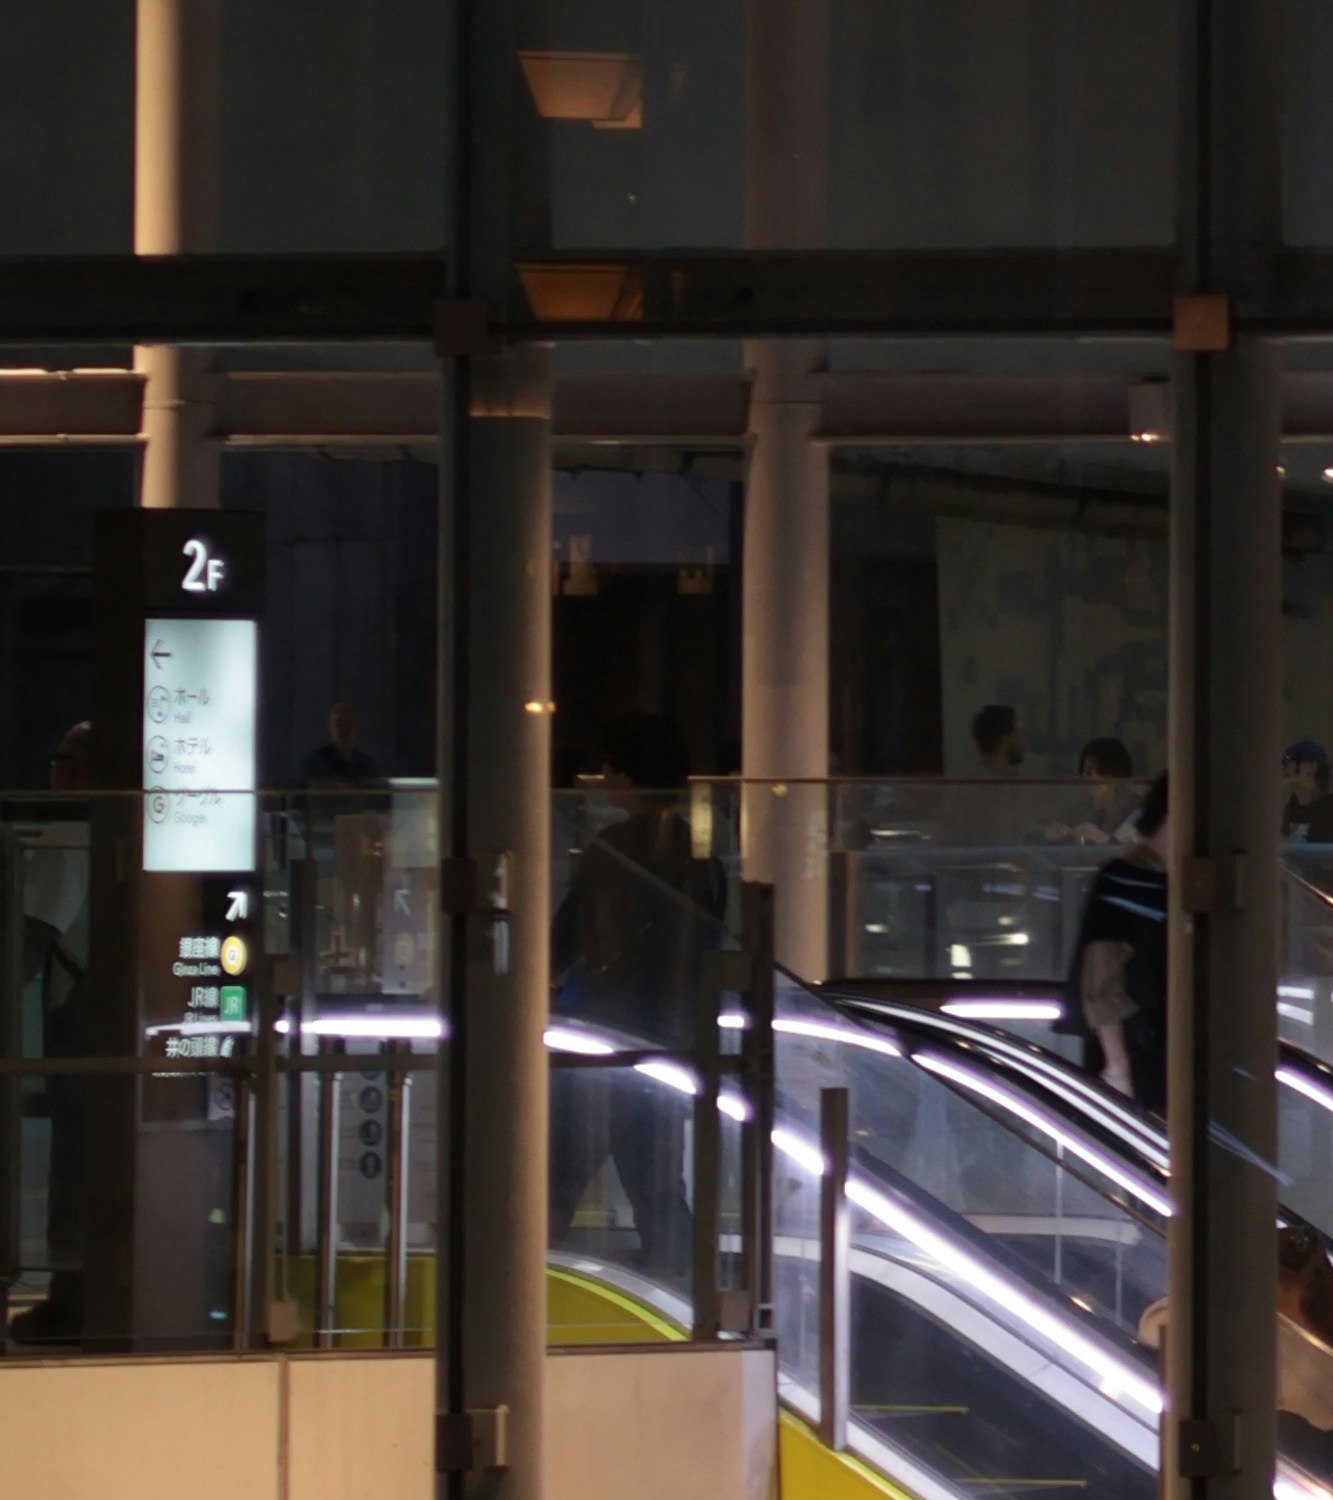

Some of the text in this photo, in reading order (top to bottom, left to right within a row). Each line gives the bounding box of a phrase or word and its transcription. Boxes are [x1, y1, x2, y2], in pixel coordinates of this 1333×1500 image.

[181, 540, 224, 591] 2F
[173, 688, 211, 707] ホール
[173, 738, 211, 755] ホテル
[165, 1036, 218, 1058] 井の頭線
